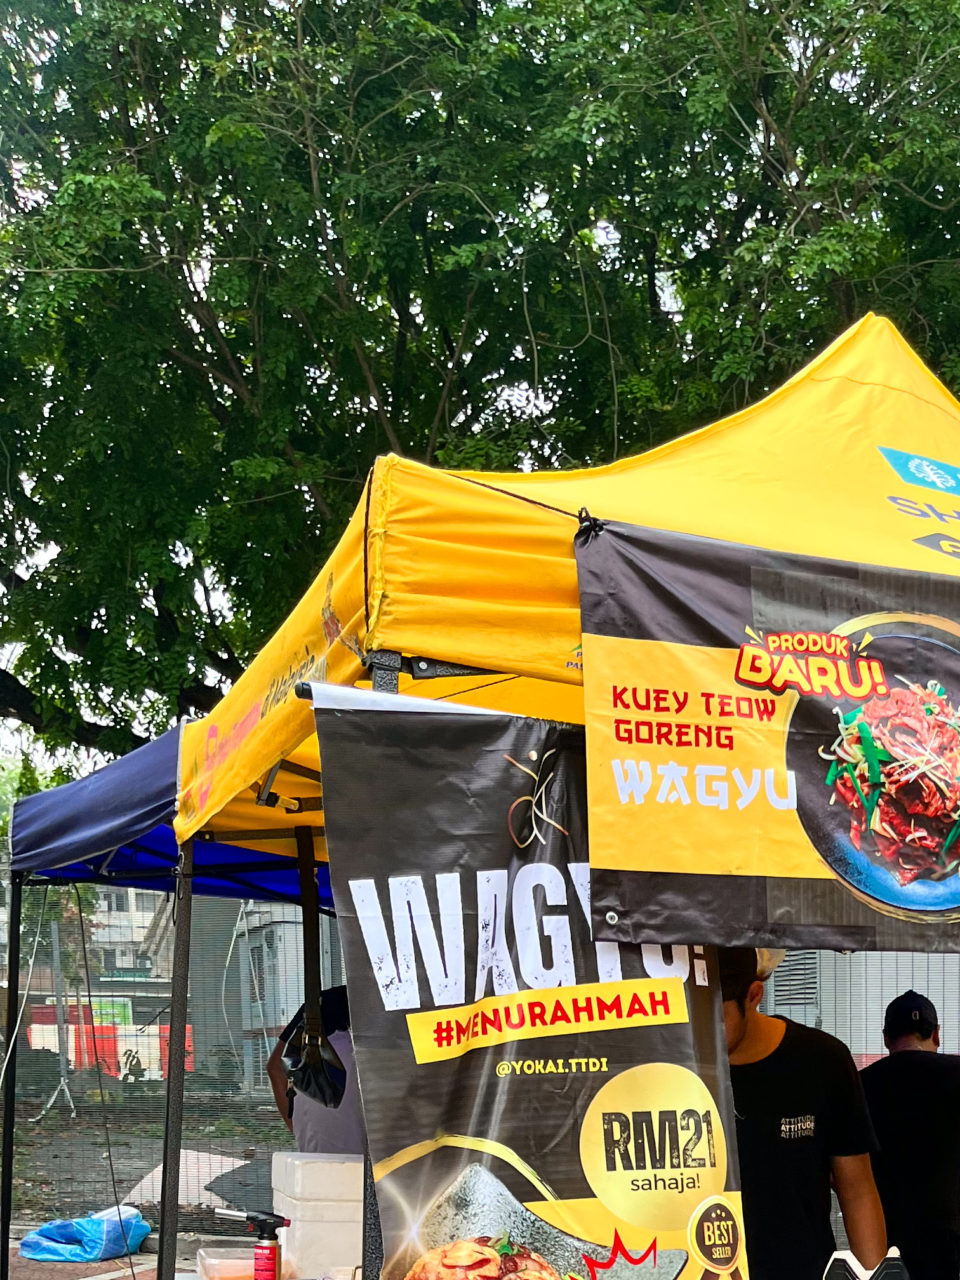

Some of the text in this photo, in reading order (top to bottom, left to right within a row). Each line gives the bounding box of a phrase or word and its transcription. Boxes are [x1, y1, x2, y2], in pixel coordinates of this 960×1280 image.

[766, 633, 848, 658] PRODUK
[737, 645, 888, 698] BARU!
[611, 685, 776, 722] KUEY TEOW
[614, 718, 734, 751] GORENG
[611, 759, 798, 811] WAGYU
[433, 990, 671, 1048] #MENURAHMAH
[495, 1056, 609, 1079] @YOKAI.TTDI
[601, 1108, 716, 1172] RM21
[780, 1121, 815, 1132] ATTITUDE
[631, 1173, 701, 1194] sahaja!
[703, 1220, 734, 1247] BEST
[711, 1246, 733, 1259] SELLER
